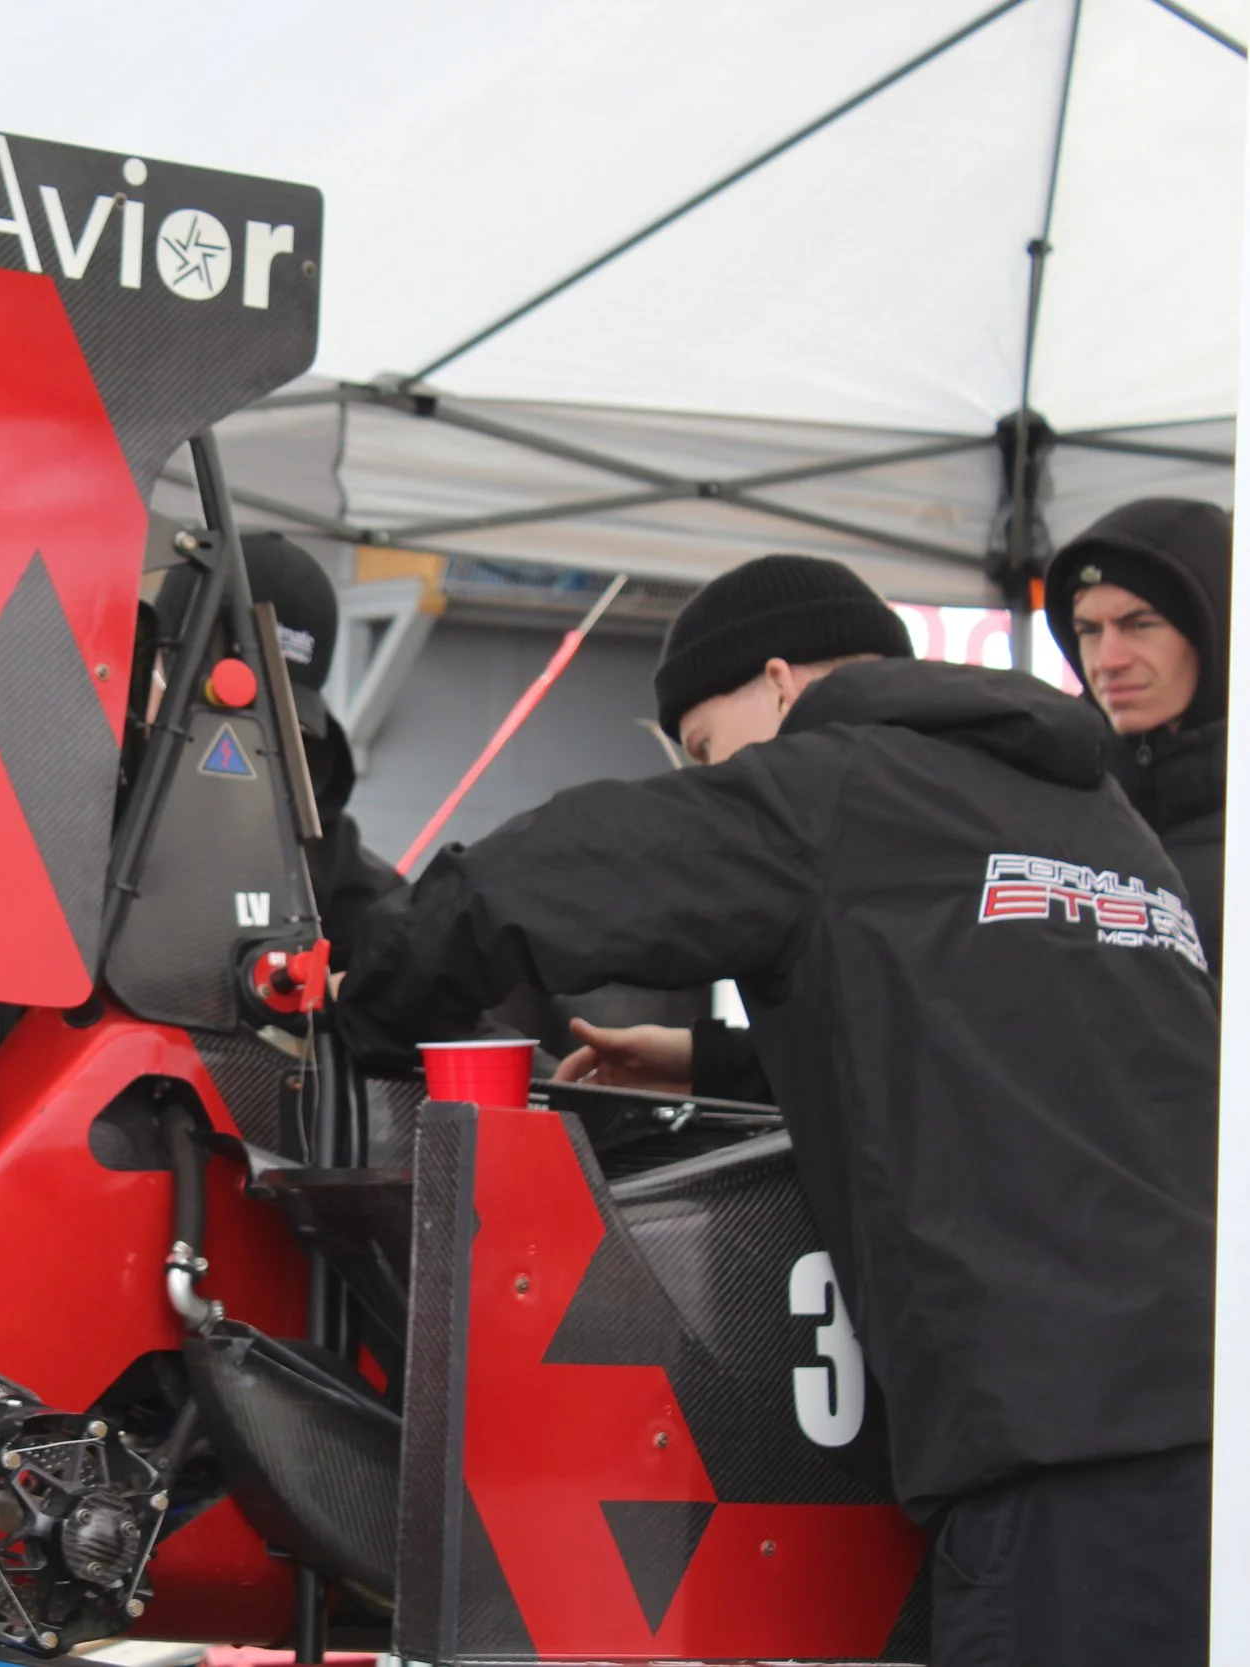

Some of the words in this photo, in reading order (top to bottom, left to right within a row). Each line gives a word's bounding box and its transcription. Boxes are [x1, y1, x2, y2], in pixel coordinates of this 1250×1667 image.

[235, 892, 270, 927] LV
[978, 881, 1148, 931] ETS
[789, 1250, 866, 1447] 3
